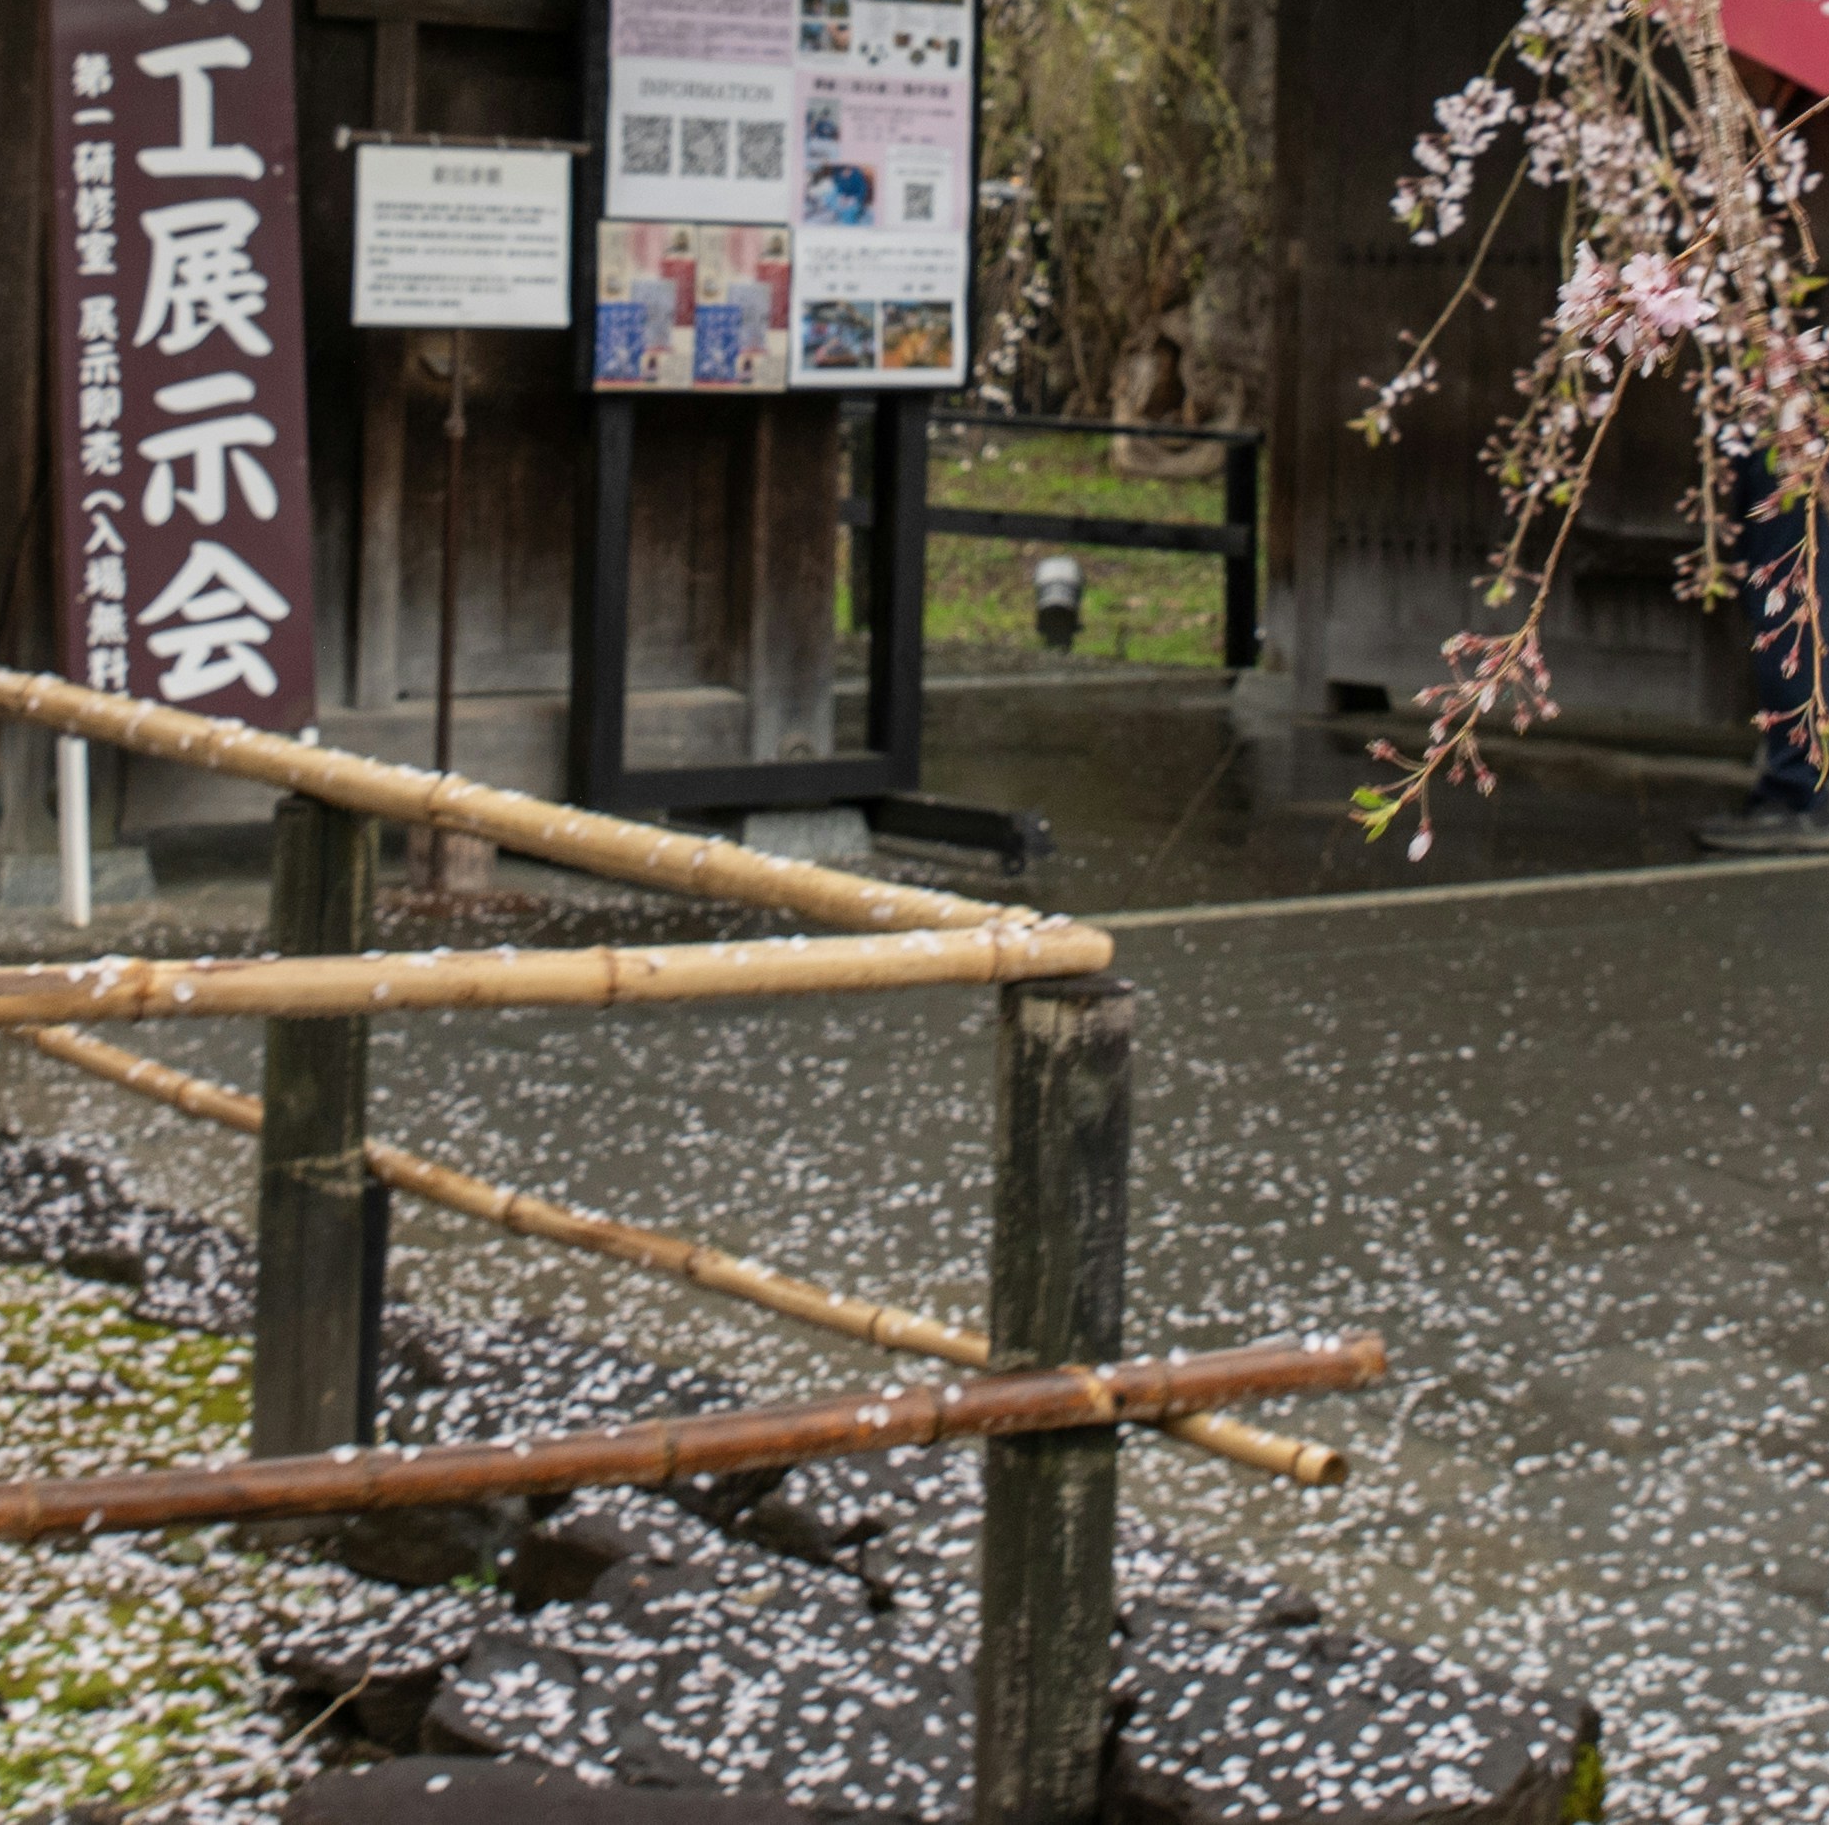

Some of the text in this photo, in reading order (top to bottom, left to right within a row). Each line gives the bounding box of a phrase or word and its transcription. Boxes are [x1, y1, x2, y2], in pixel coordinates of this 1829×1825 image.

[72, 52, 119, 276] 第一研修室
